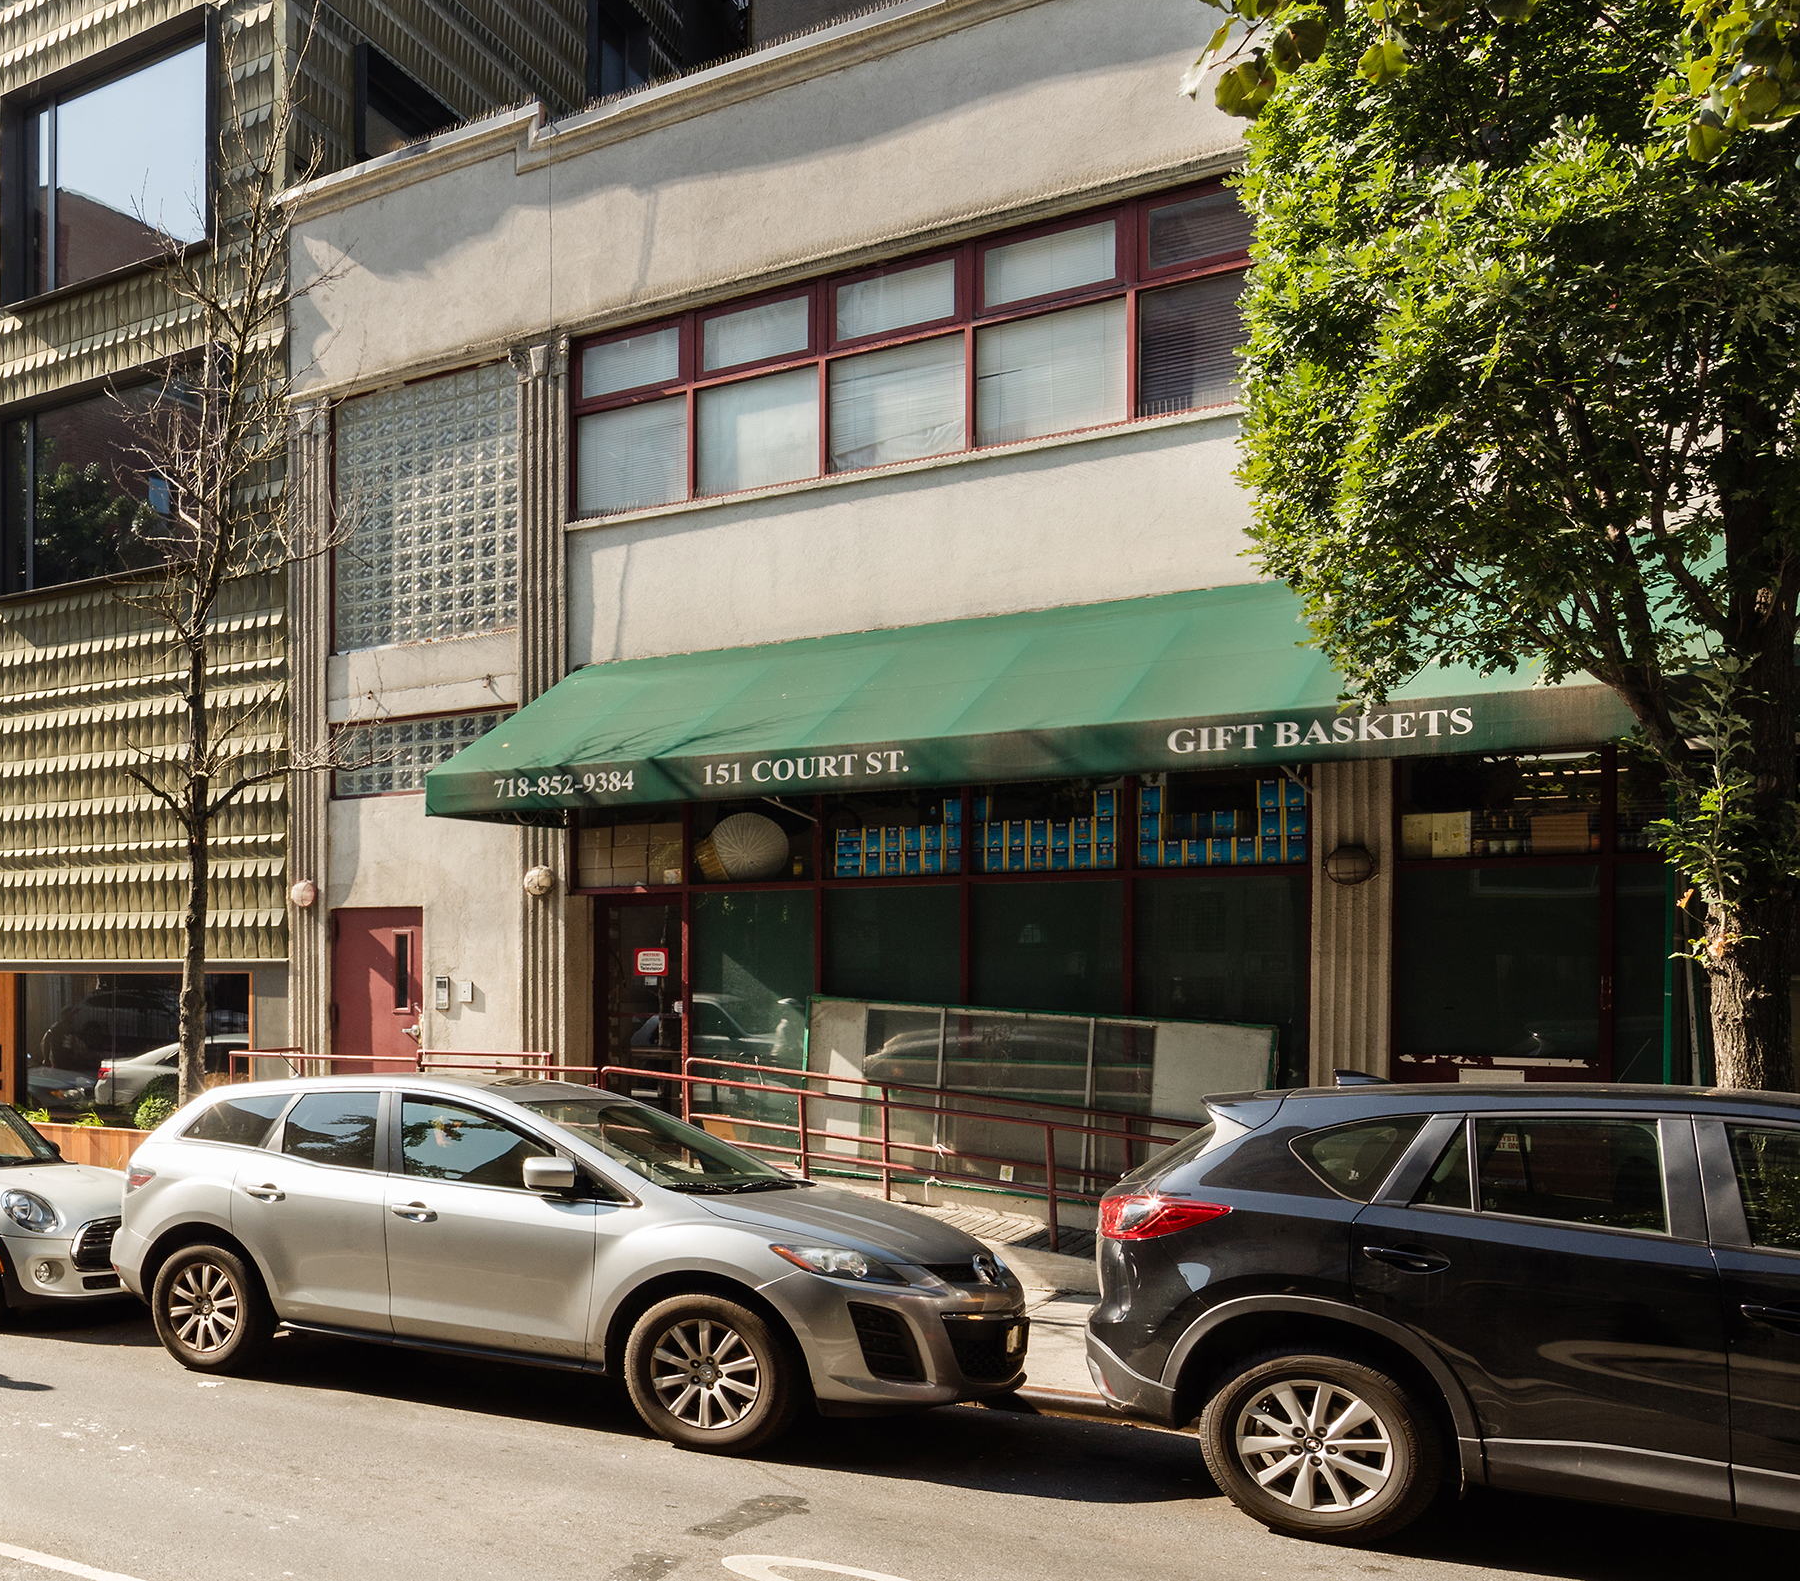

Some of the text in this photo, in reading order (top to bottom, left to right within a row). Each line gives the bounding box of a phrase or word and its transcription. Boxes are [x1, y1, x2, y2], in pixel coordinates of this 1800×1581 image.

[1166, 706, 1474, 754] GIFT BASKETS
[493, 770, 634, 798] 718-852-9384
[703, 750, 909, 786] 151 COURT ST.
